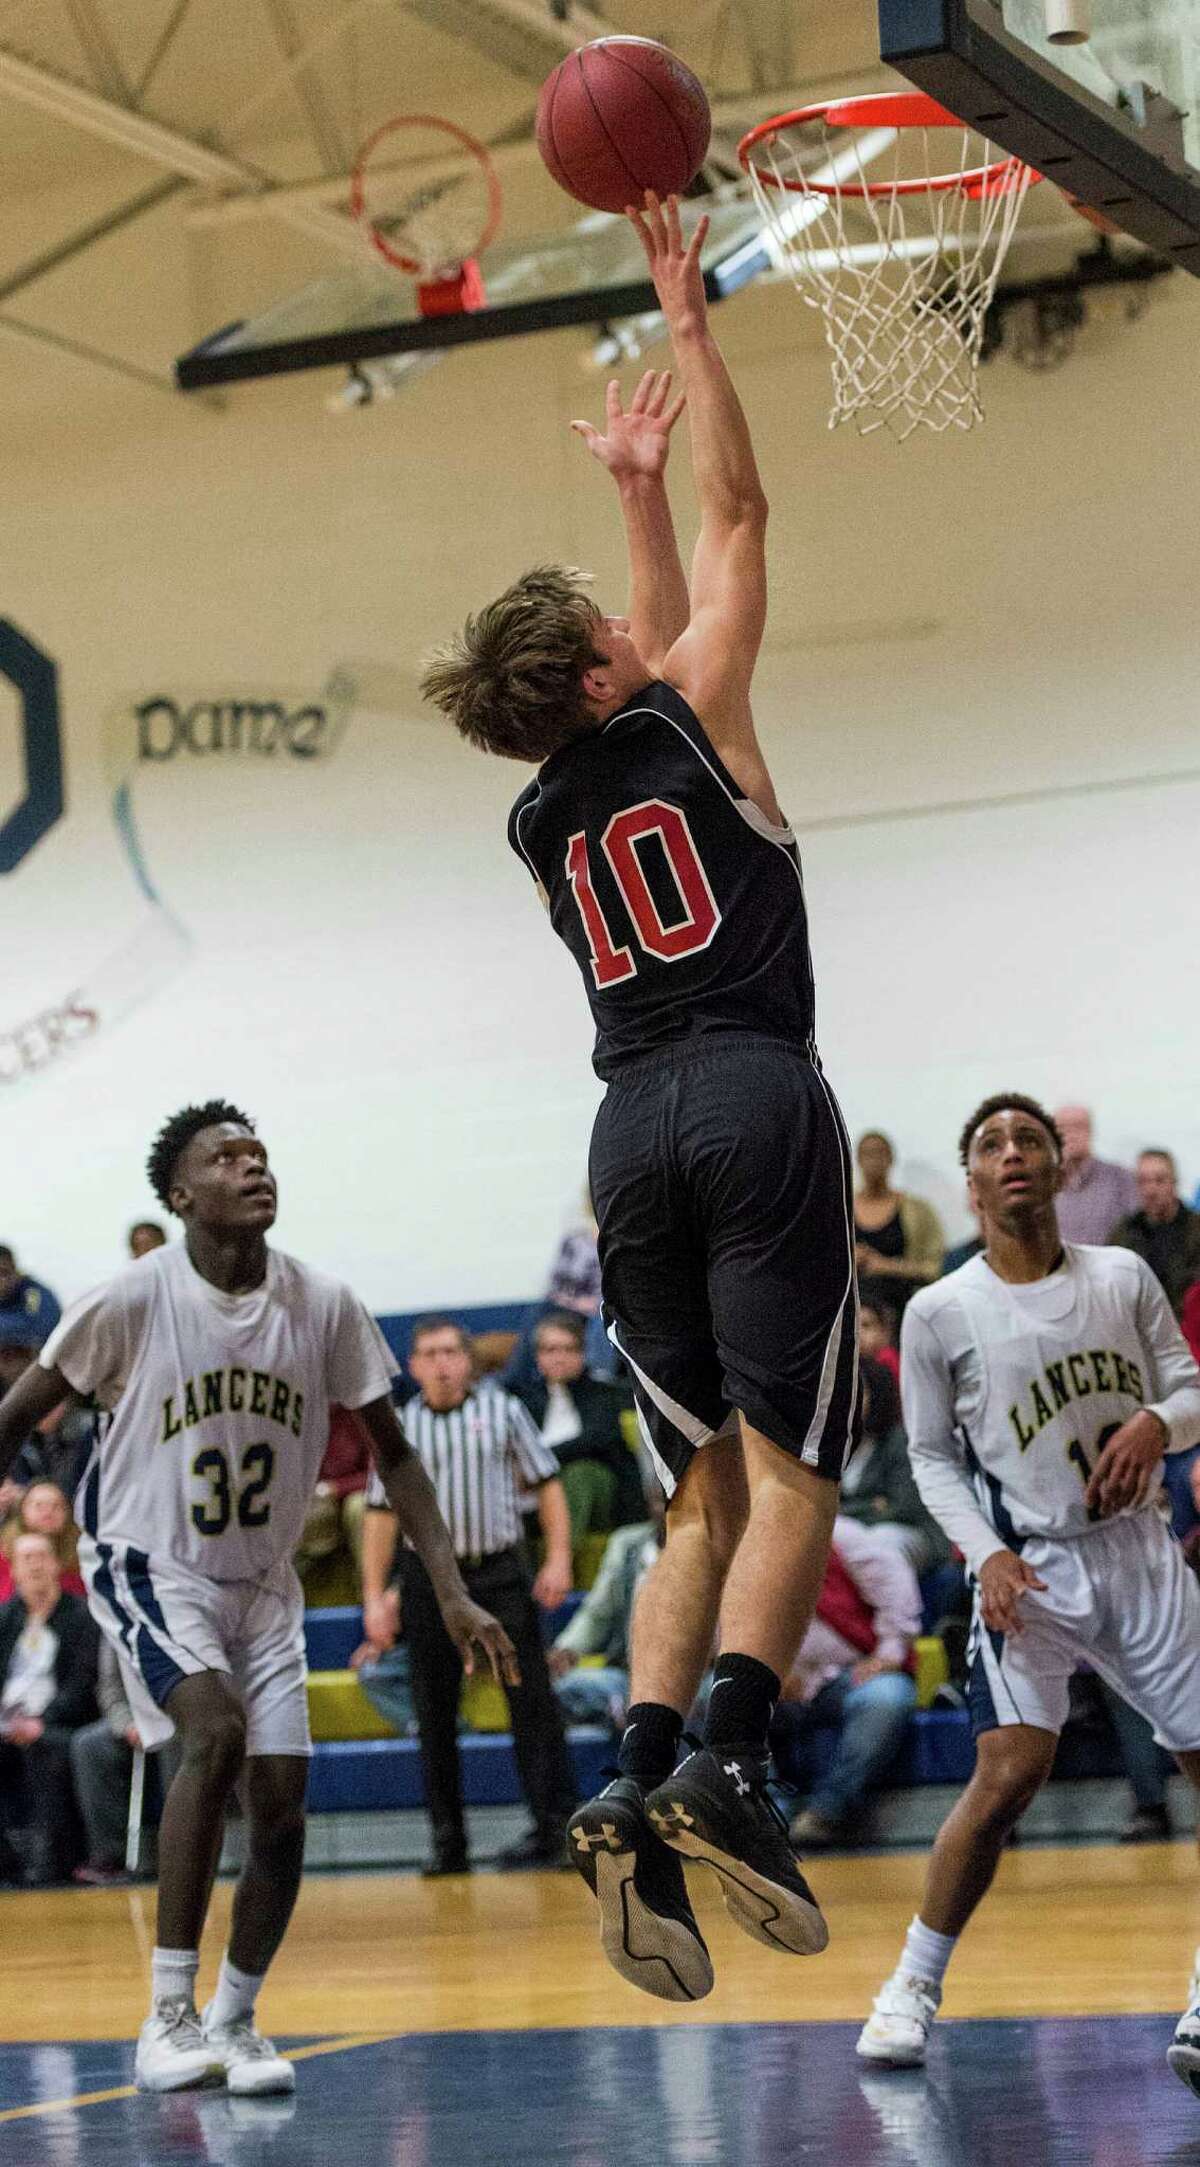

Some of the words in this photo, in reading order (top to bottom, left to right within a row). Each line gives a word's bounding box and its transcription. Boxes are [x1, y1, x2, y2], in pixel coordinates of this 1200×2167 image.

[565, 798, 722, 990] 10
[161, 1366, 306, 1443] LANCERS
[190, 1440, 275, 1537] 32
